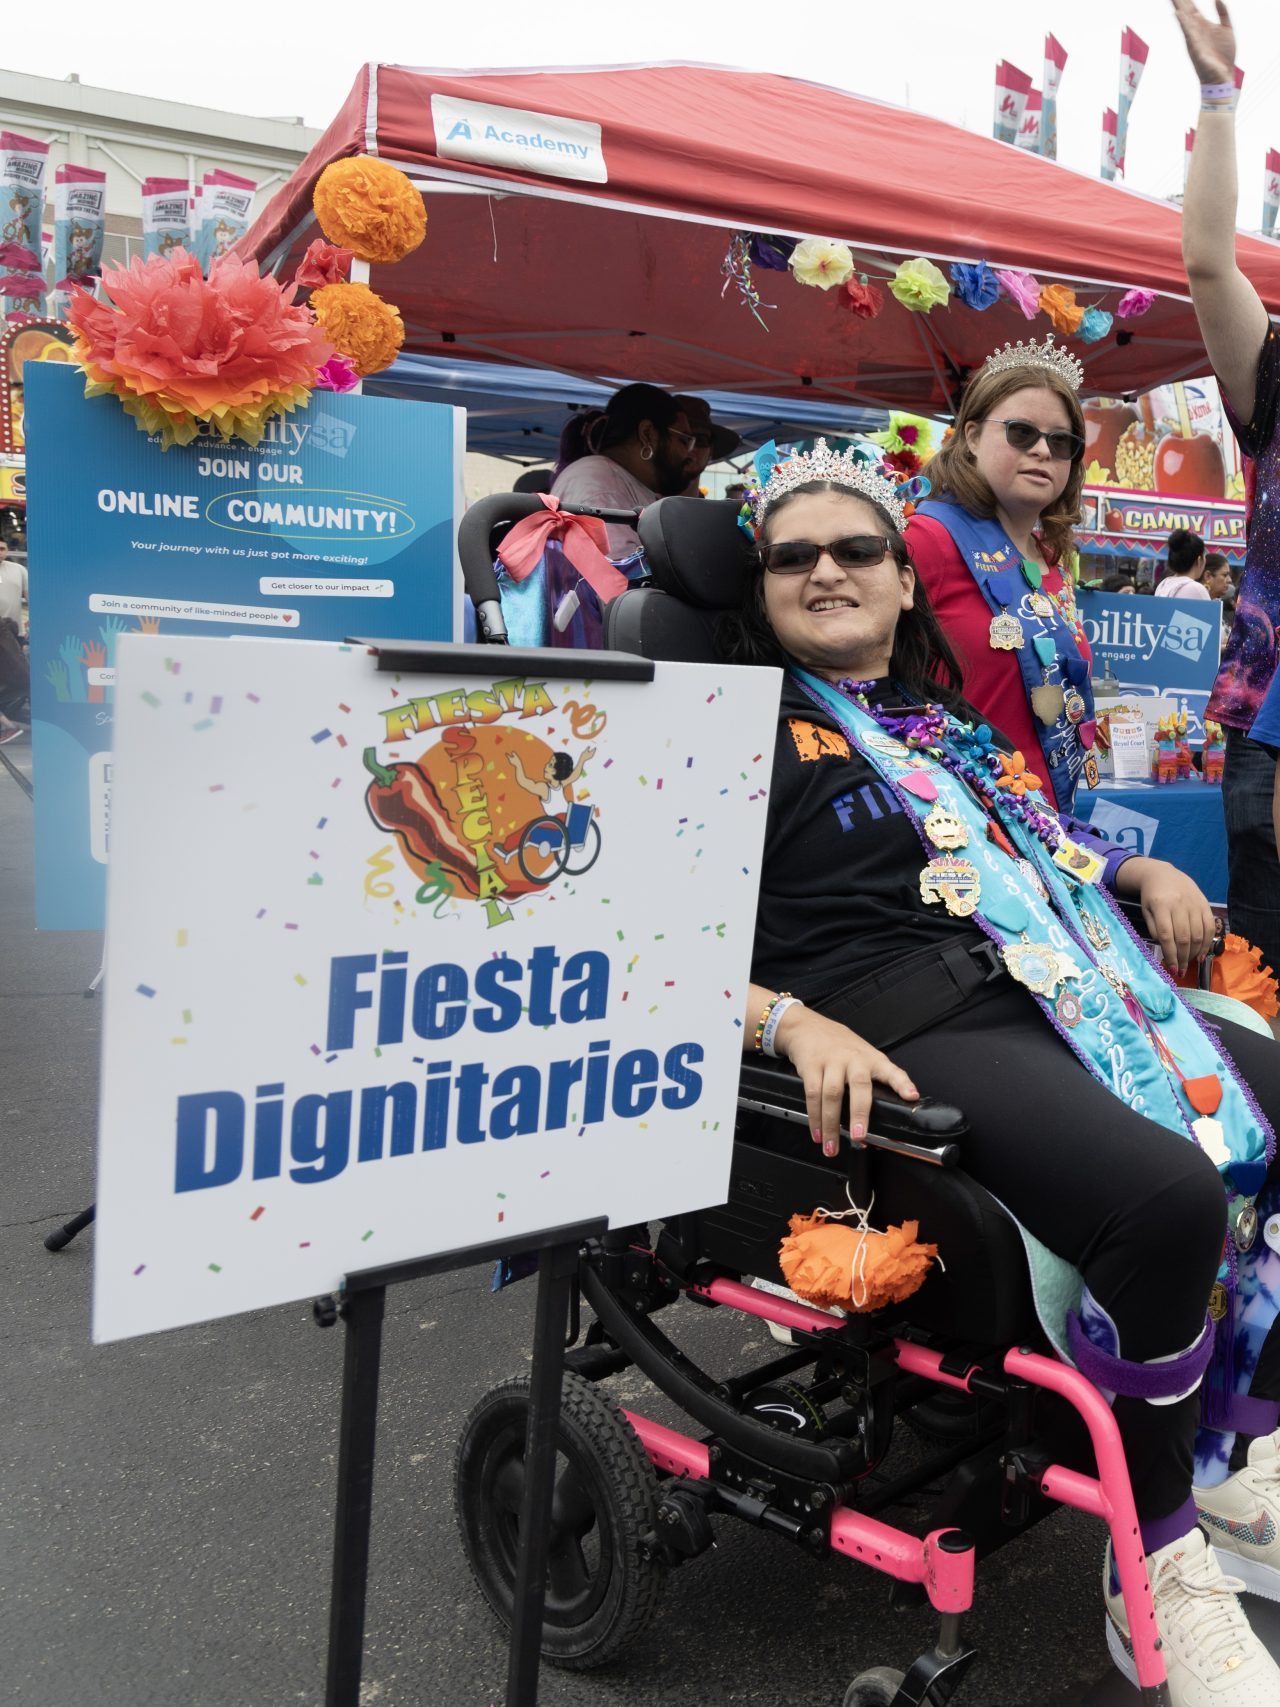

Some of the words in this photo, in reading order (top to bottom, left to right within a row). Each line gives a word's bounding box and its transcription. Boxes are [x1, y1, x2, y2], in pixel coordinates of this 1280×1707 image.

[485, 124, 589, 159] Academy
[197, 441, 237, 450] advance
[248, 446, 283, 455] engage
[198, 457, 250, 479] JOIN
[258, 463, 303, 484] OUR
[98, 489, 200, 519] ONLINE
[227, 499, 396, 533] COMMUNITY!
[1125, 511, 1204, 532] CANDY
[131, 541, 157, 550] Your
[158, 542, 202, 554] journey
[205, 545, 230, 555] with
[247, 548, 268, 558] just
[271, 552, 289, 561] got
[322, 555, 368, 566] exciting!
[341, 583, 370, 592] impact
[101, 600, 120, 608] Join
[130, 602, 182, 614] community
[195, 607, 247, 618] like-minded
[249, 612, 279, 622] people
[1102, 651, 1136, 661] engage
[376, 676, 556, 743] FIESTA
[441, 726, 514, 930] SPECIAL
[325, 945, 610, 1052] Fiesta
[173, 1040, 705, 1194] Dignitaries
